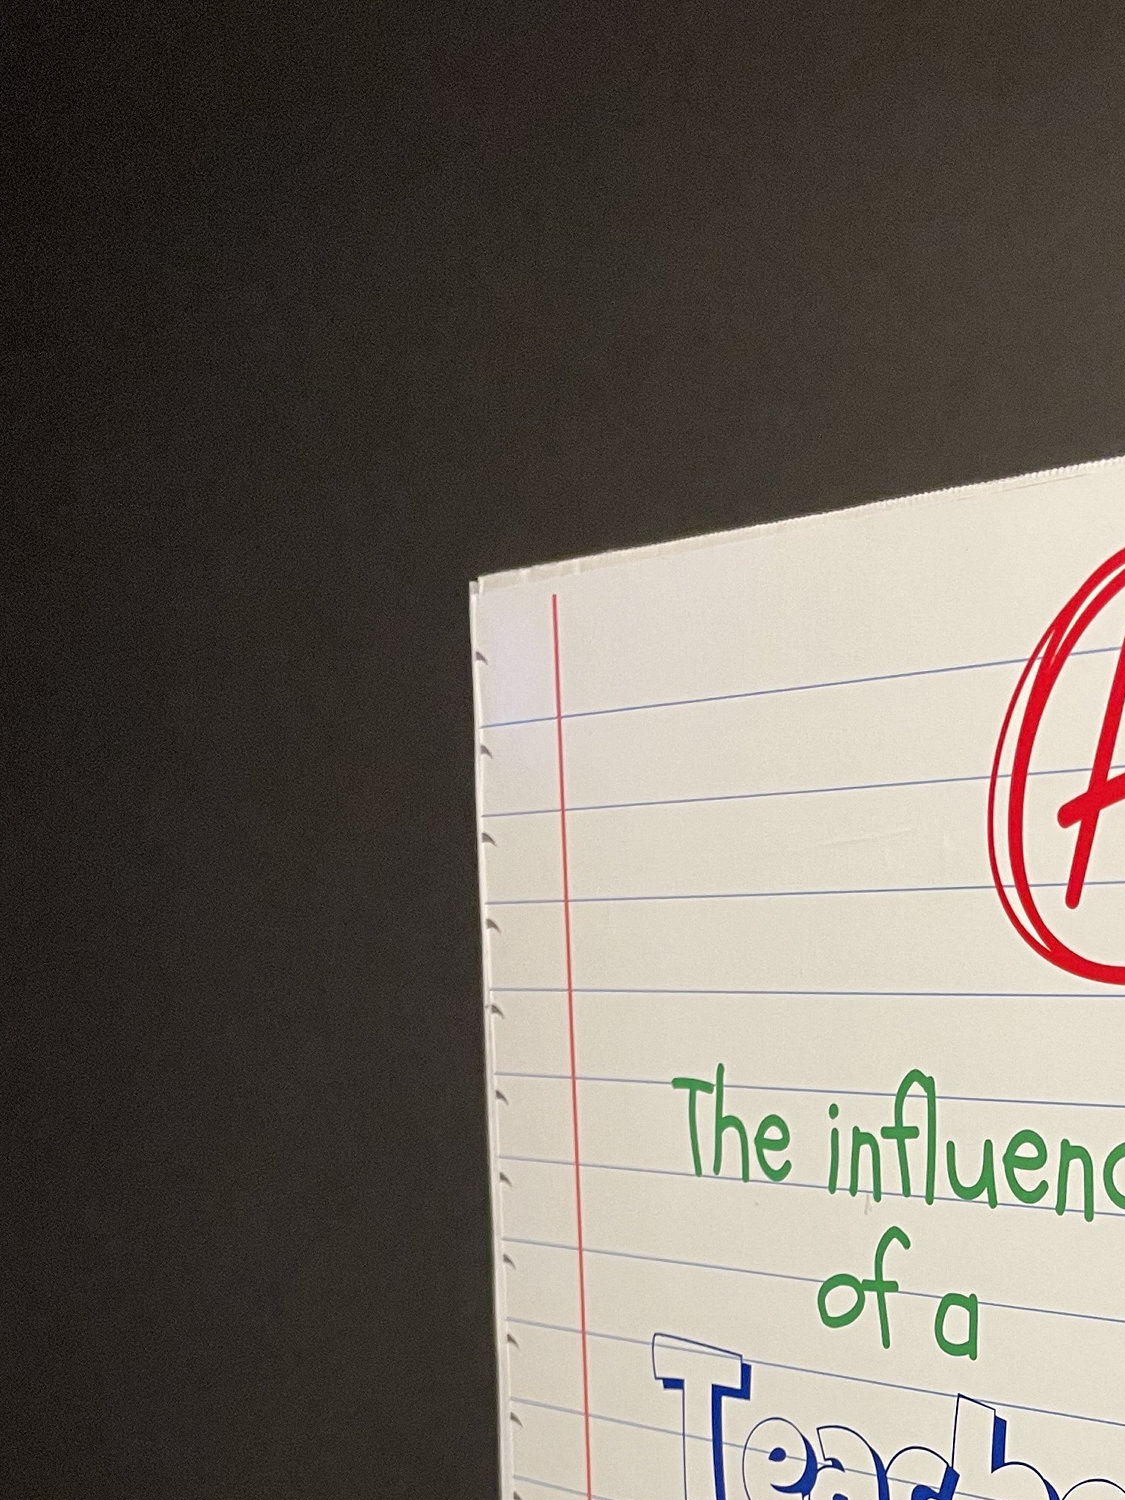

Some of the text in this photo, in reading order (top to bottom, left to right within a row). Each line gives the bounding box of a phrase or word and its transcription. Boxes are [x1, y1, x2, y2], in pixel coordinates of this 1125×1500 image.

[672, 1063, 792, 1182] The
[817, 1226, 978, 1361] of a
